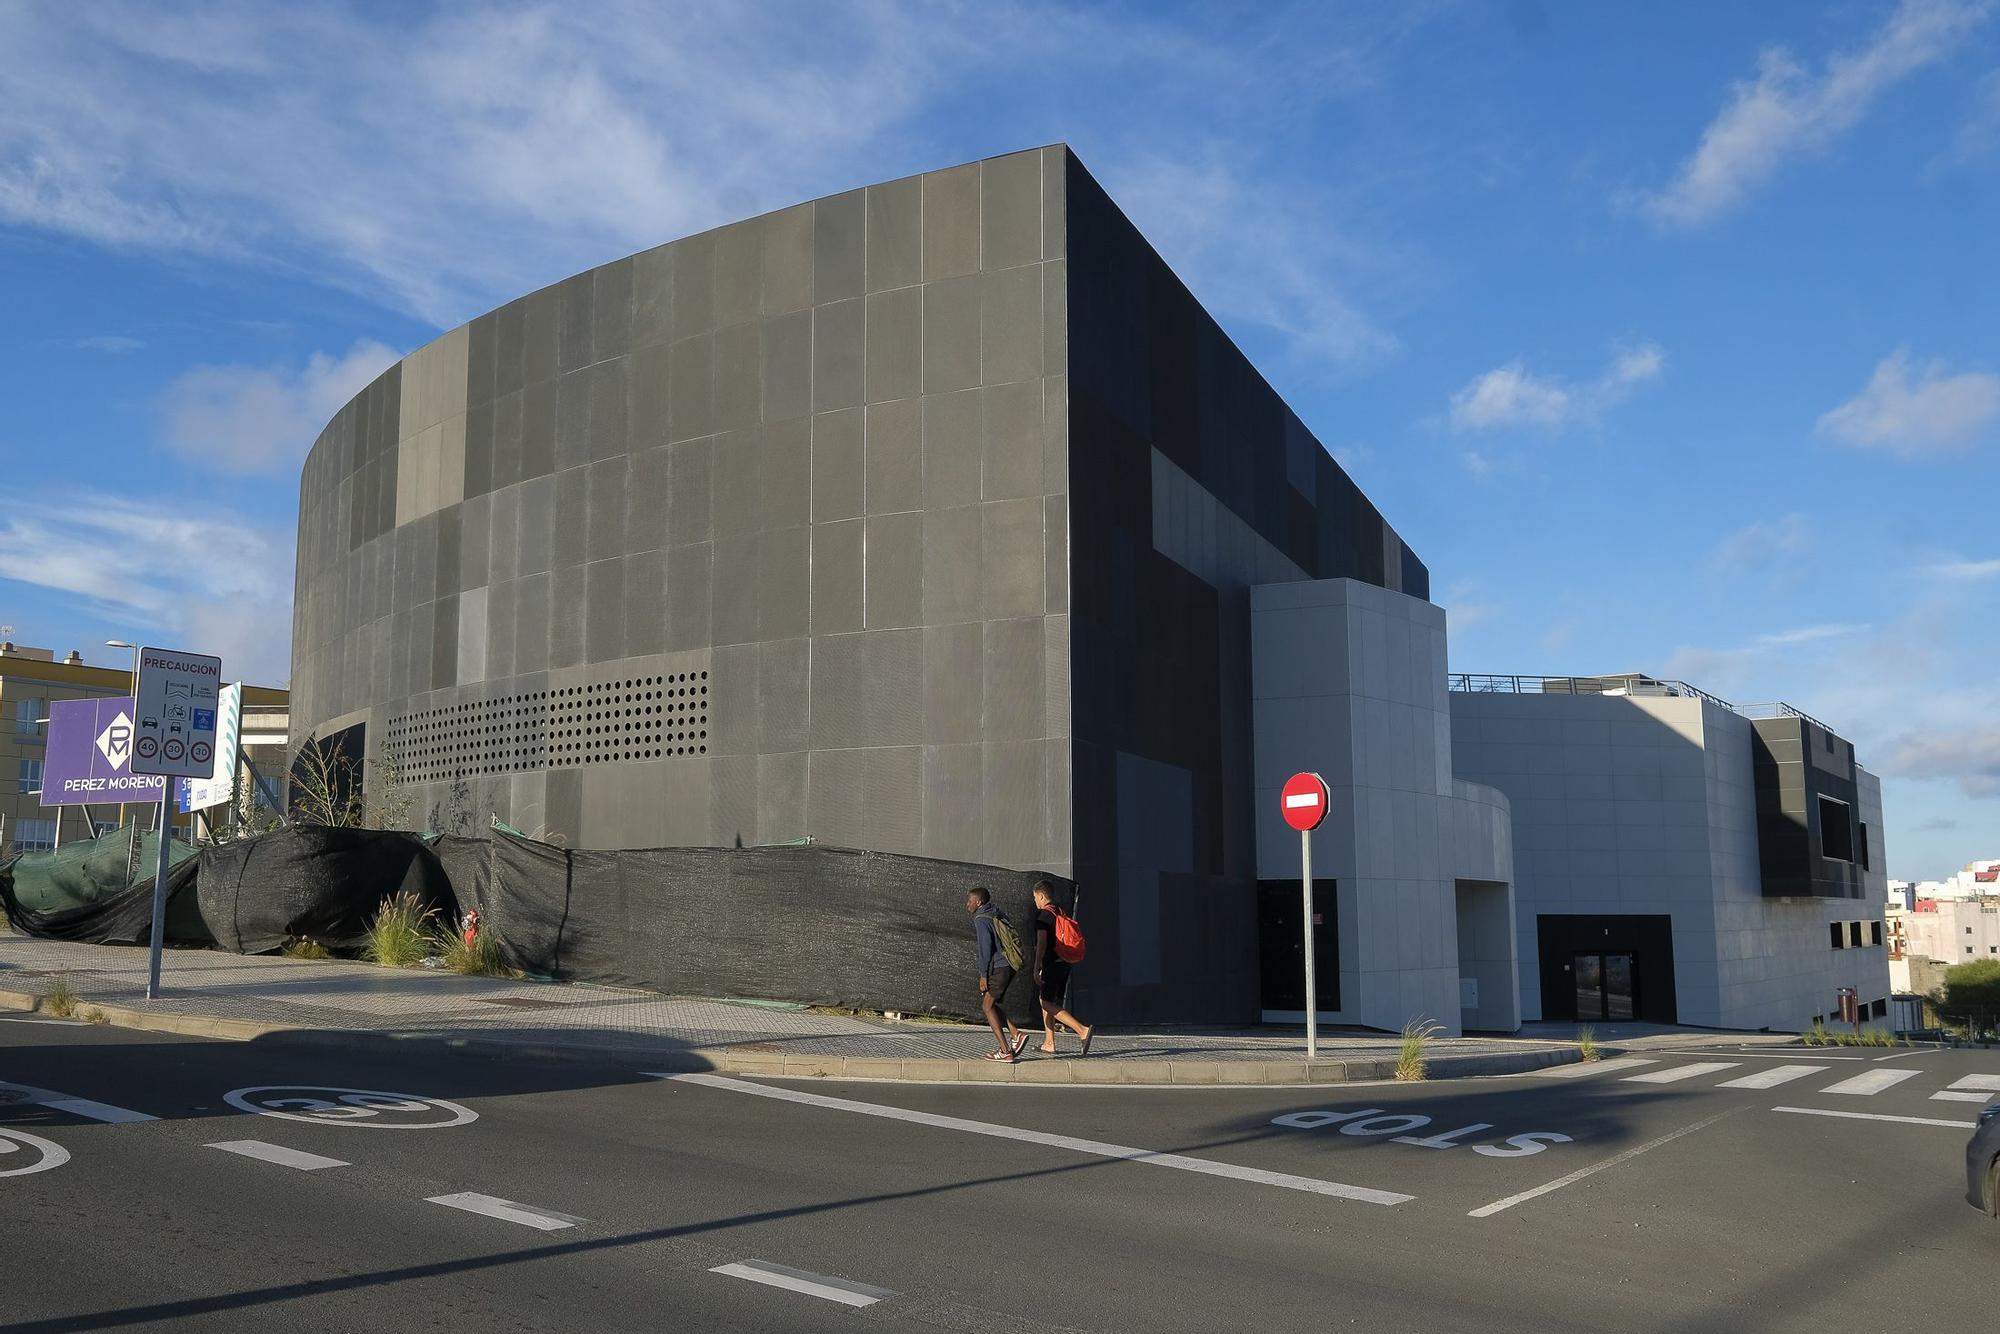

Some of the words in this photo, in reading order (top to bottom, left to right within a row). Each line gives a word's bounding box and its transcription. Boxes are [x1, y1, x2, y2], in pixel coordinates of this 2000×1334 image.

[144, 657, 217, 676] PRECAUCIÓN
[141, 743, 154, 751] 40
[168, 745, 180, 753] 30
[195, 748, 207, 756] 30
[64, 778, 107, 791] PEREZ
[108, 775, 165, 790] MORENO
[1271, 1108, 1574, 1158] STOP
